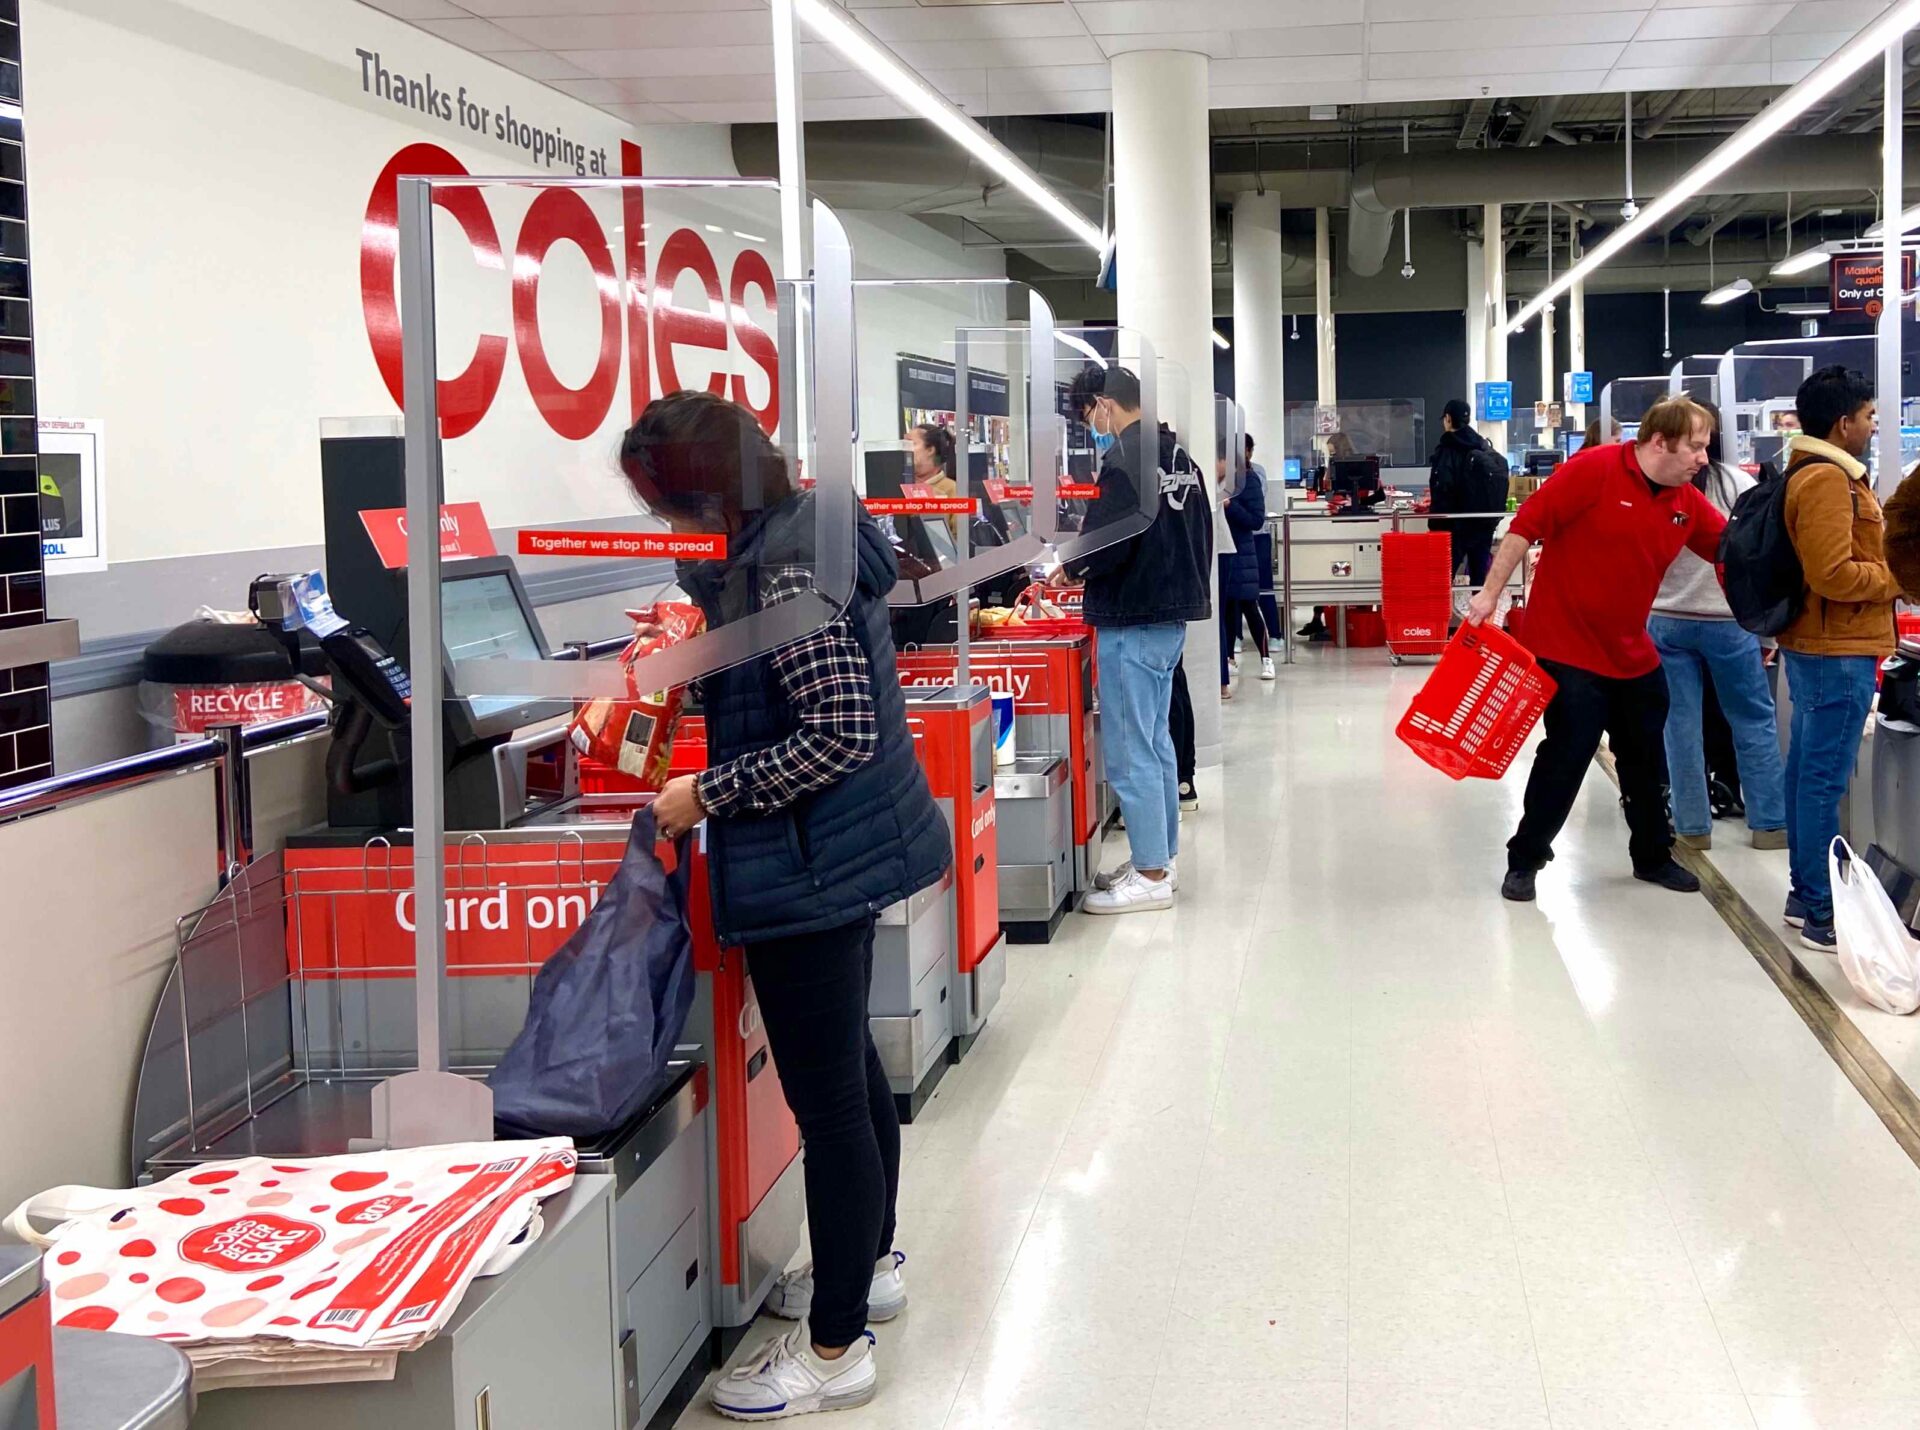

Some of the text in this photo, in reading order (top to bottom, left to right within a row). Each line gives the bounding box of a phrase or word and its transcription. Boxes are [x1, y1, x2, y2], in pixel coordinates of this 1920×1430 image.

[355, 48, 607, 176] Thanks for shopping at
[1844, 266, 1883, 275] MasterC
[360, 139, 779, 440] coles
[1839, 289, 1861, 299] Only
[1864, 288, 1874, 297] at
[1010, 488, 1033, 496] Togethe
[864, 502, 889, 510] gether
[905, 502, 923, 511] stop
[924, 502, 938, 510] the
[940, 502, 969, 511] spread
[42, 519, 60, 531] LUS
[440, 510, 459, 536] nly
[42, 544, 65, 555] ZOLL
[530, 536, 713, 553] Together we stop the spread
[1057, 592, 1083, 603] Ca
[1403, 626, 1431, 636] coles
[970, 667, 1030, 699] only
[191, 691, 284, 713] RECYCLE
[971, 809, 984, 840] Card
[527, 879, 598, 929] onl
[202, 1219, 258, 1254] coles
[220, 1223, 276, 1261] BETTER
[238, 1229, 306, 1264] BAG
